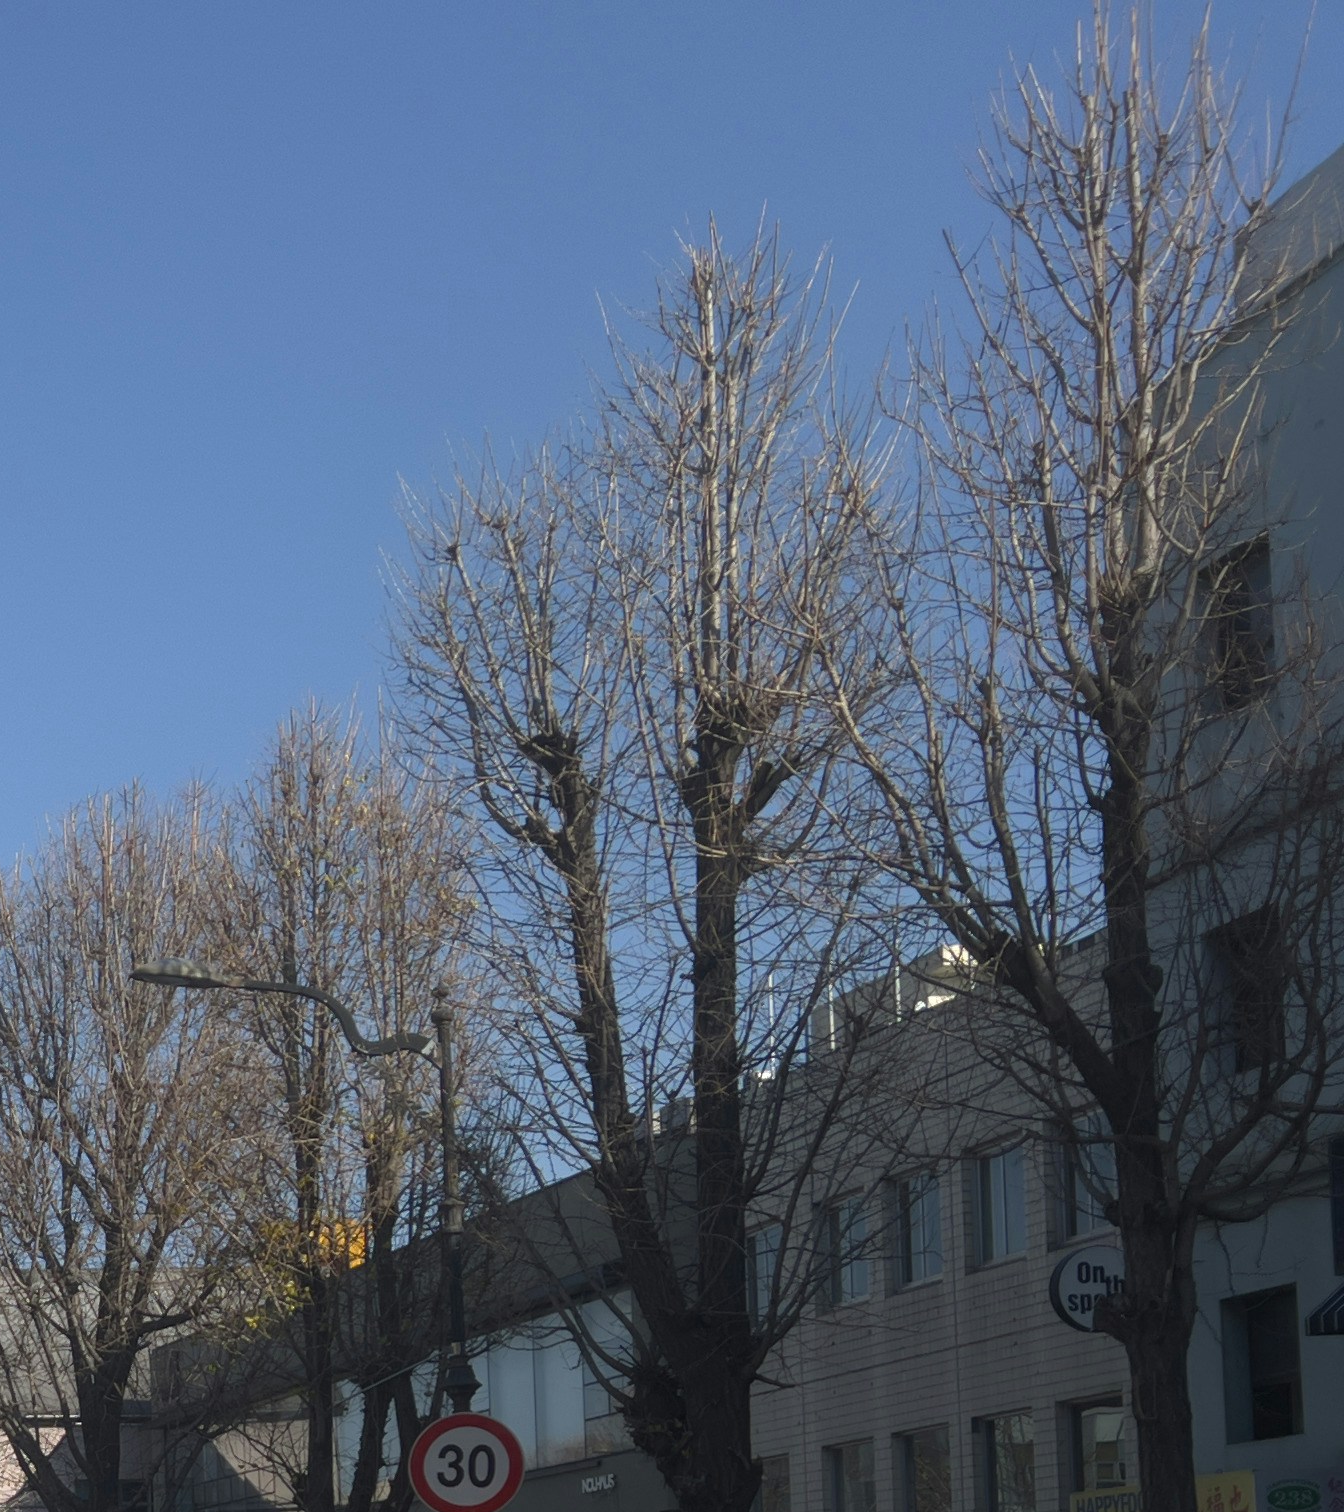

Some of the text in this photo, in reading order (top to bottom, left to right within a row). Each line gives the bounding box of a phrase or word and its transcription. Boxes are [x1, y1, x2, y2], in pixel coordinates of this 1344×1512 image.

[1077, 1261, 1105, 1284] On
[1104, 1274, 1127, 1297] th
[1067, 1292, 1105, 1315] sp
[436, 1443, 496, 1489] 30
